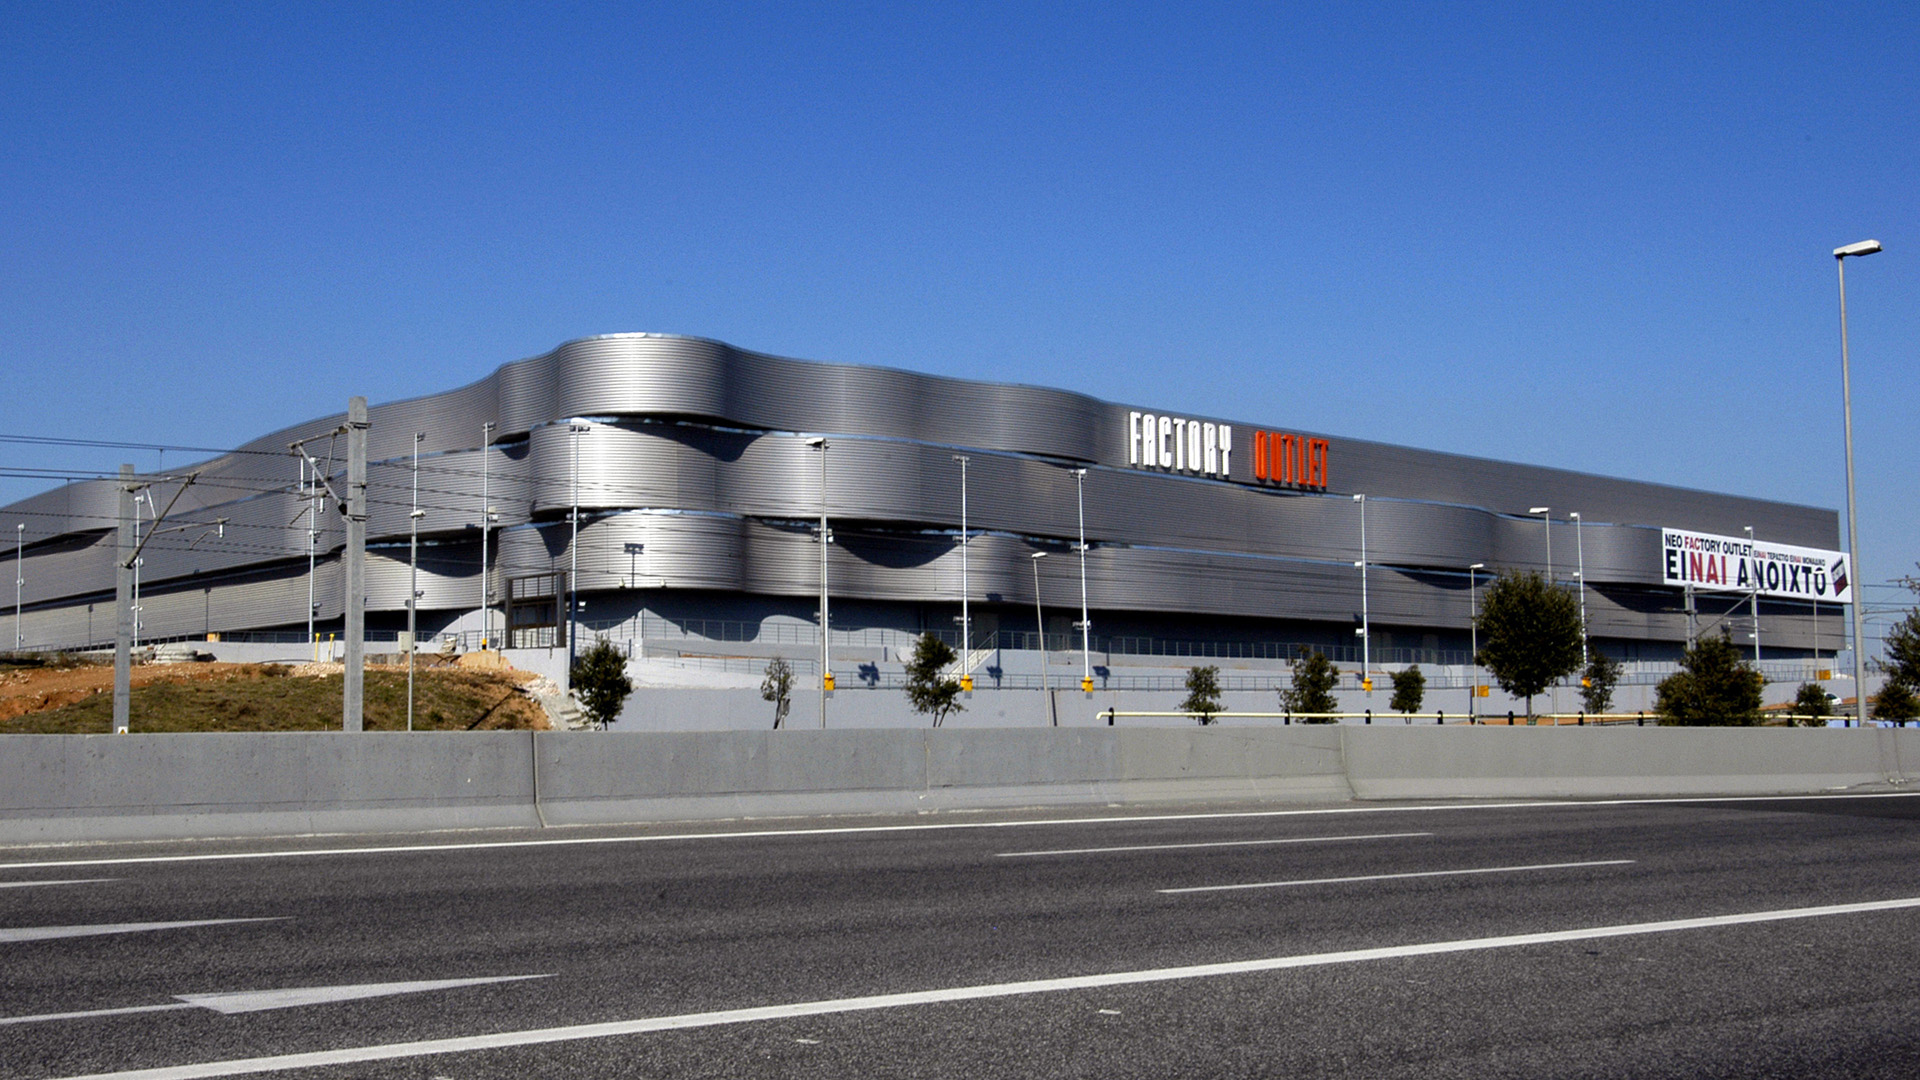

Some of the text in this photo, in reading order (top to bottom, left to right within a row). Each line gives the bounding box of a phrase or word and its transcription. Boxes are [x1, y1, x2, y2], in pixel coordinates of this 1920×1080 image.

[1129, 411, 1329, 488] FACTORY OUTLET
[1684, 536, 1721, 554] FACTORY
[1722, 541, 1753, 557] OUTLET
